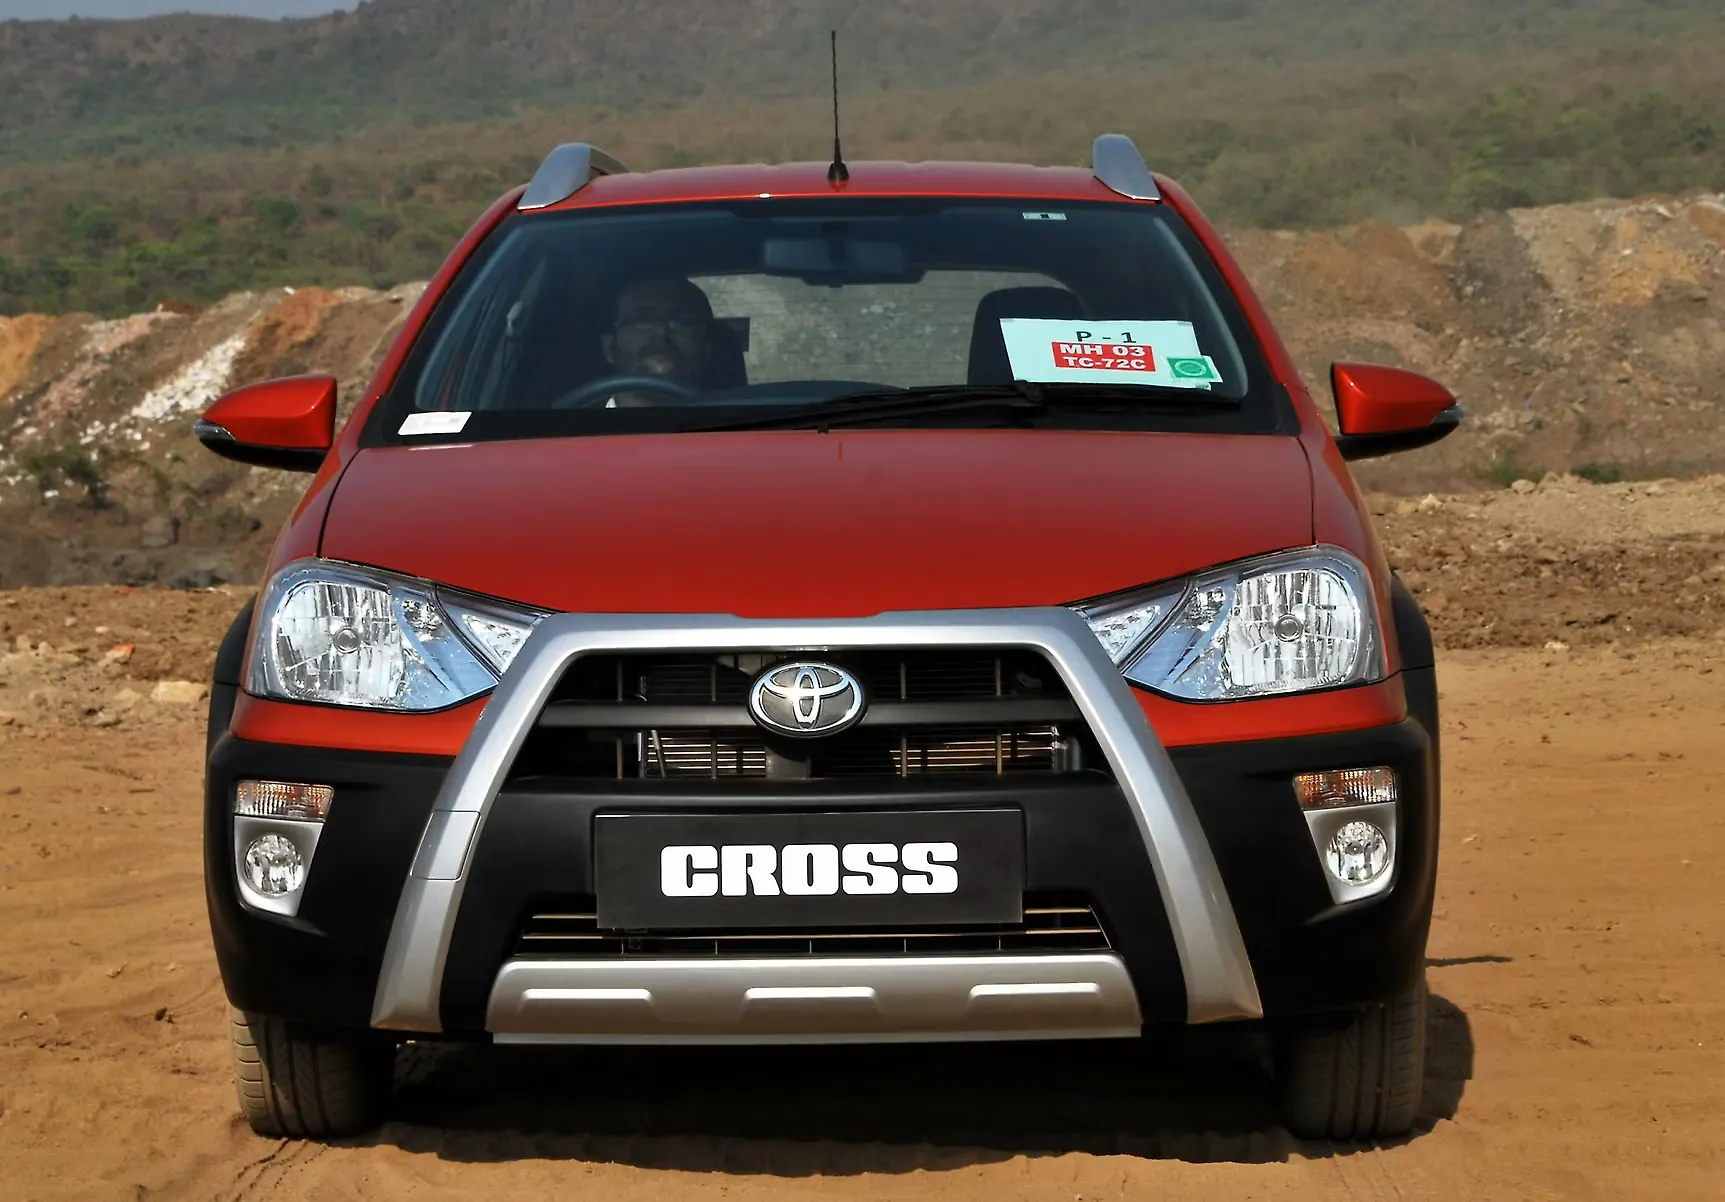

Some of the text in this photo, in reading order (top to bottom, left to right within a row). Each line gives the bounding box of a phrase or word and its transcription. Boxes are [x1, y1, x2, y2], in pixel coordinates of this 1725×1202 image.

[1060, 343, 1146, 356] MH 03
[1063, 356, 1147, 369] TC-72C
[660, 842, 959, 897] CROSS
